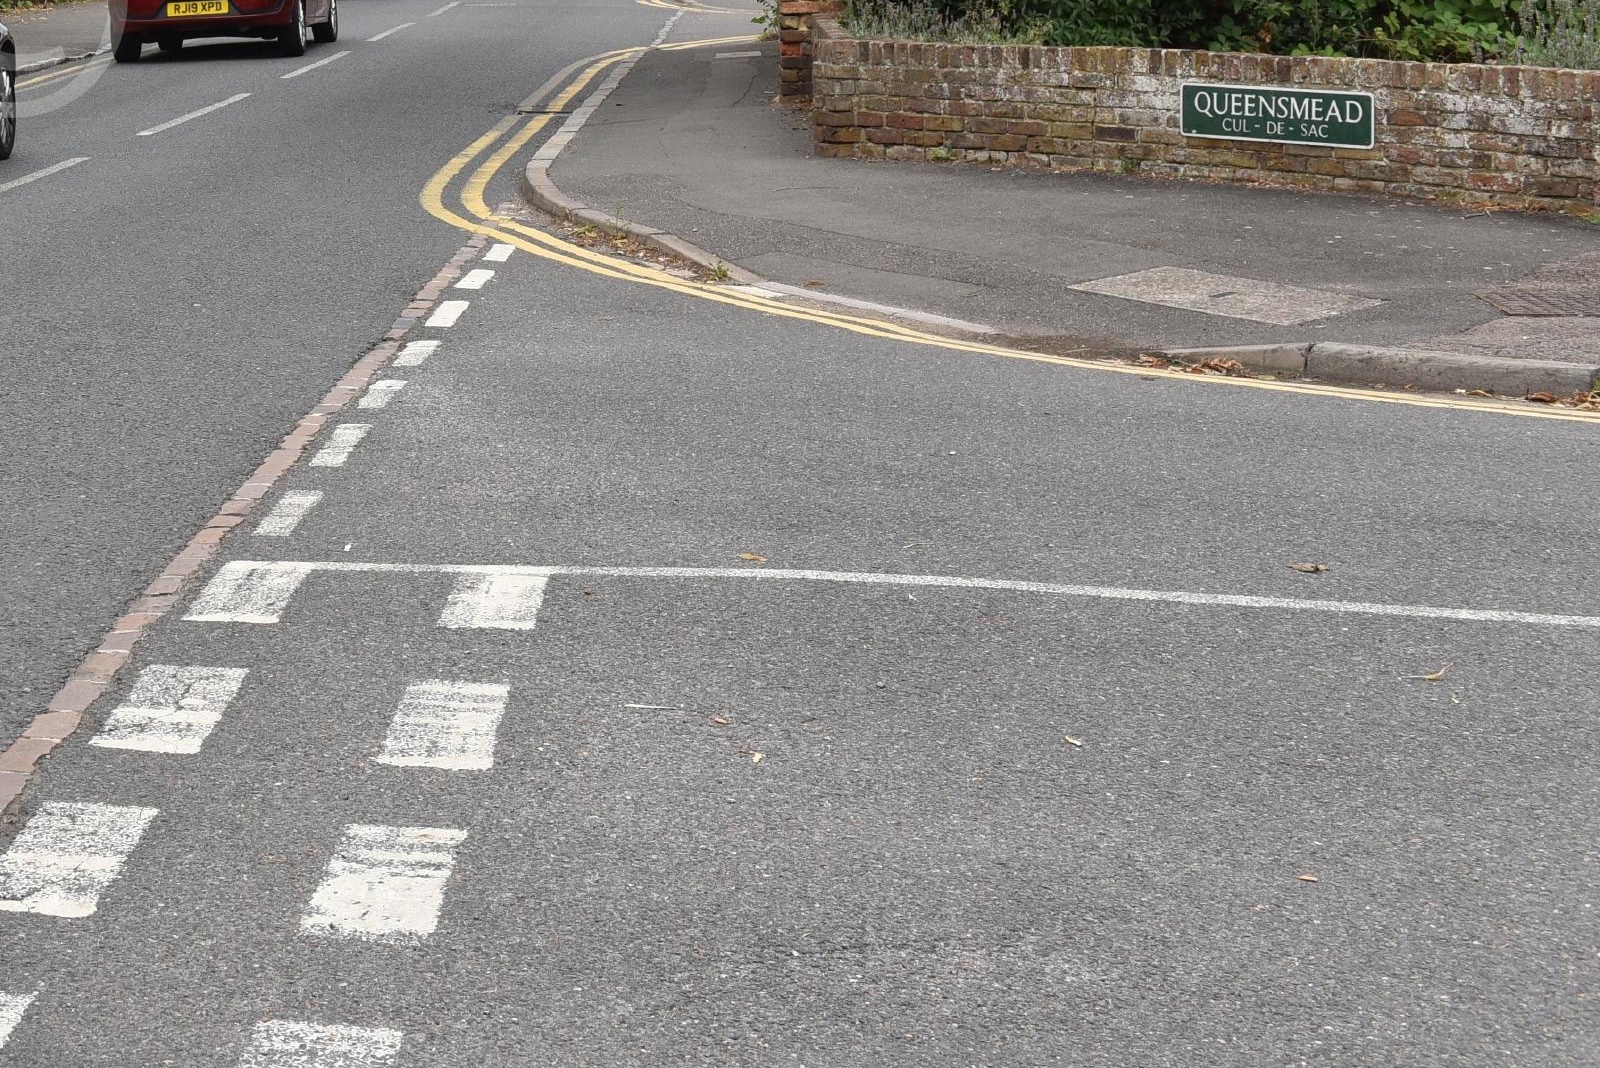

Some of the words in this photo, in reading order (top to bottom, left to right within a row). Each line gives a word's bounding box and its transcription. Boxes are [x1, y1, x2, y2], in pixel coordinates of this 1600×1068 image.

[173, 3, 198, 15] RJ19
[200, 1, 222, 13] XPD
[1193, 91, 1363, 124] QUEENSMEAD
[1222, 117, 1250, 133] CUL
[1266, 121, 1285, 135] DE
[1300, 124, 1329, 139] SAC
